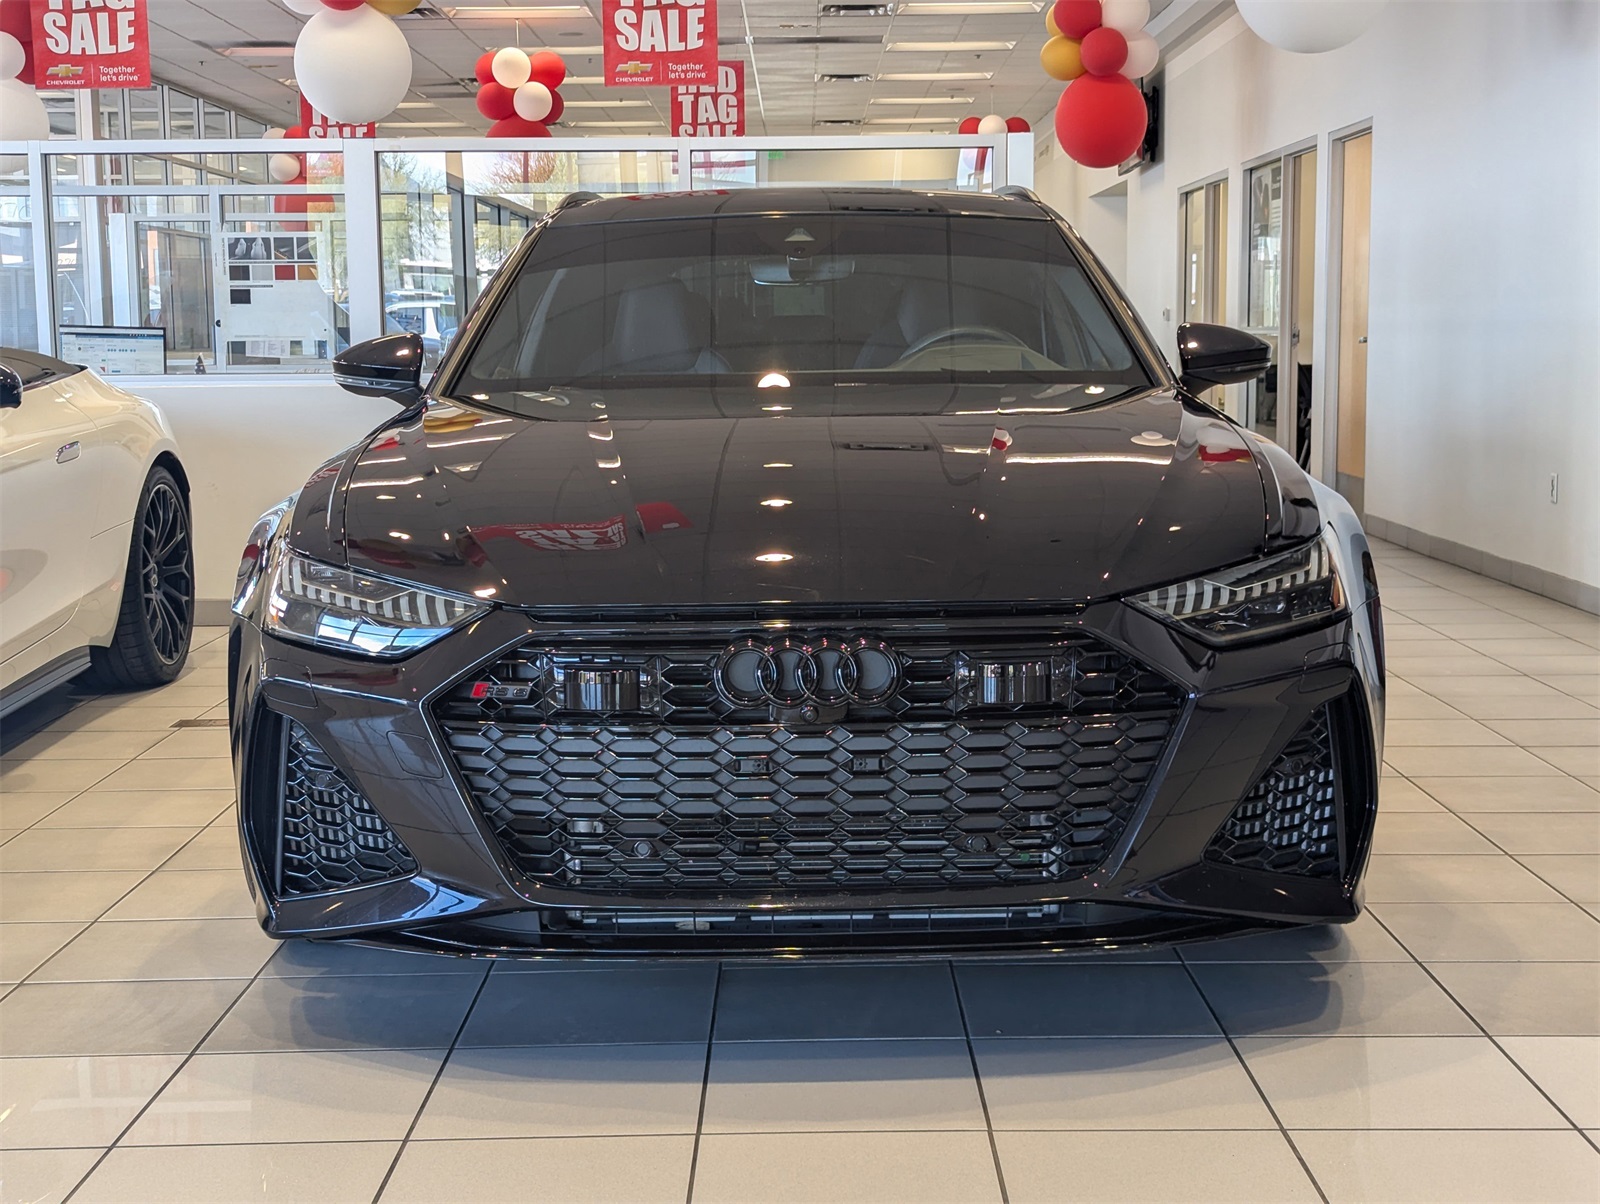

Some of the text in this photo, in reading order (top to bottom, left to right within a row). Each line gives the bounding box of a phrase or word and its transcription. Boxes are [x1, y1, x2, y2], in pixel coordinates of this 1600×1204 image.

[43, 11, 135, 55] SALE
[614, 8, 704, 52] SALE
[99, 65, 135, 74] Together
[668, 63, 703, 71] Together
[100, 74, 117, 82] let's
[669, 71, 685, 79] let's
[678, 93, 738, 124] TAG
